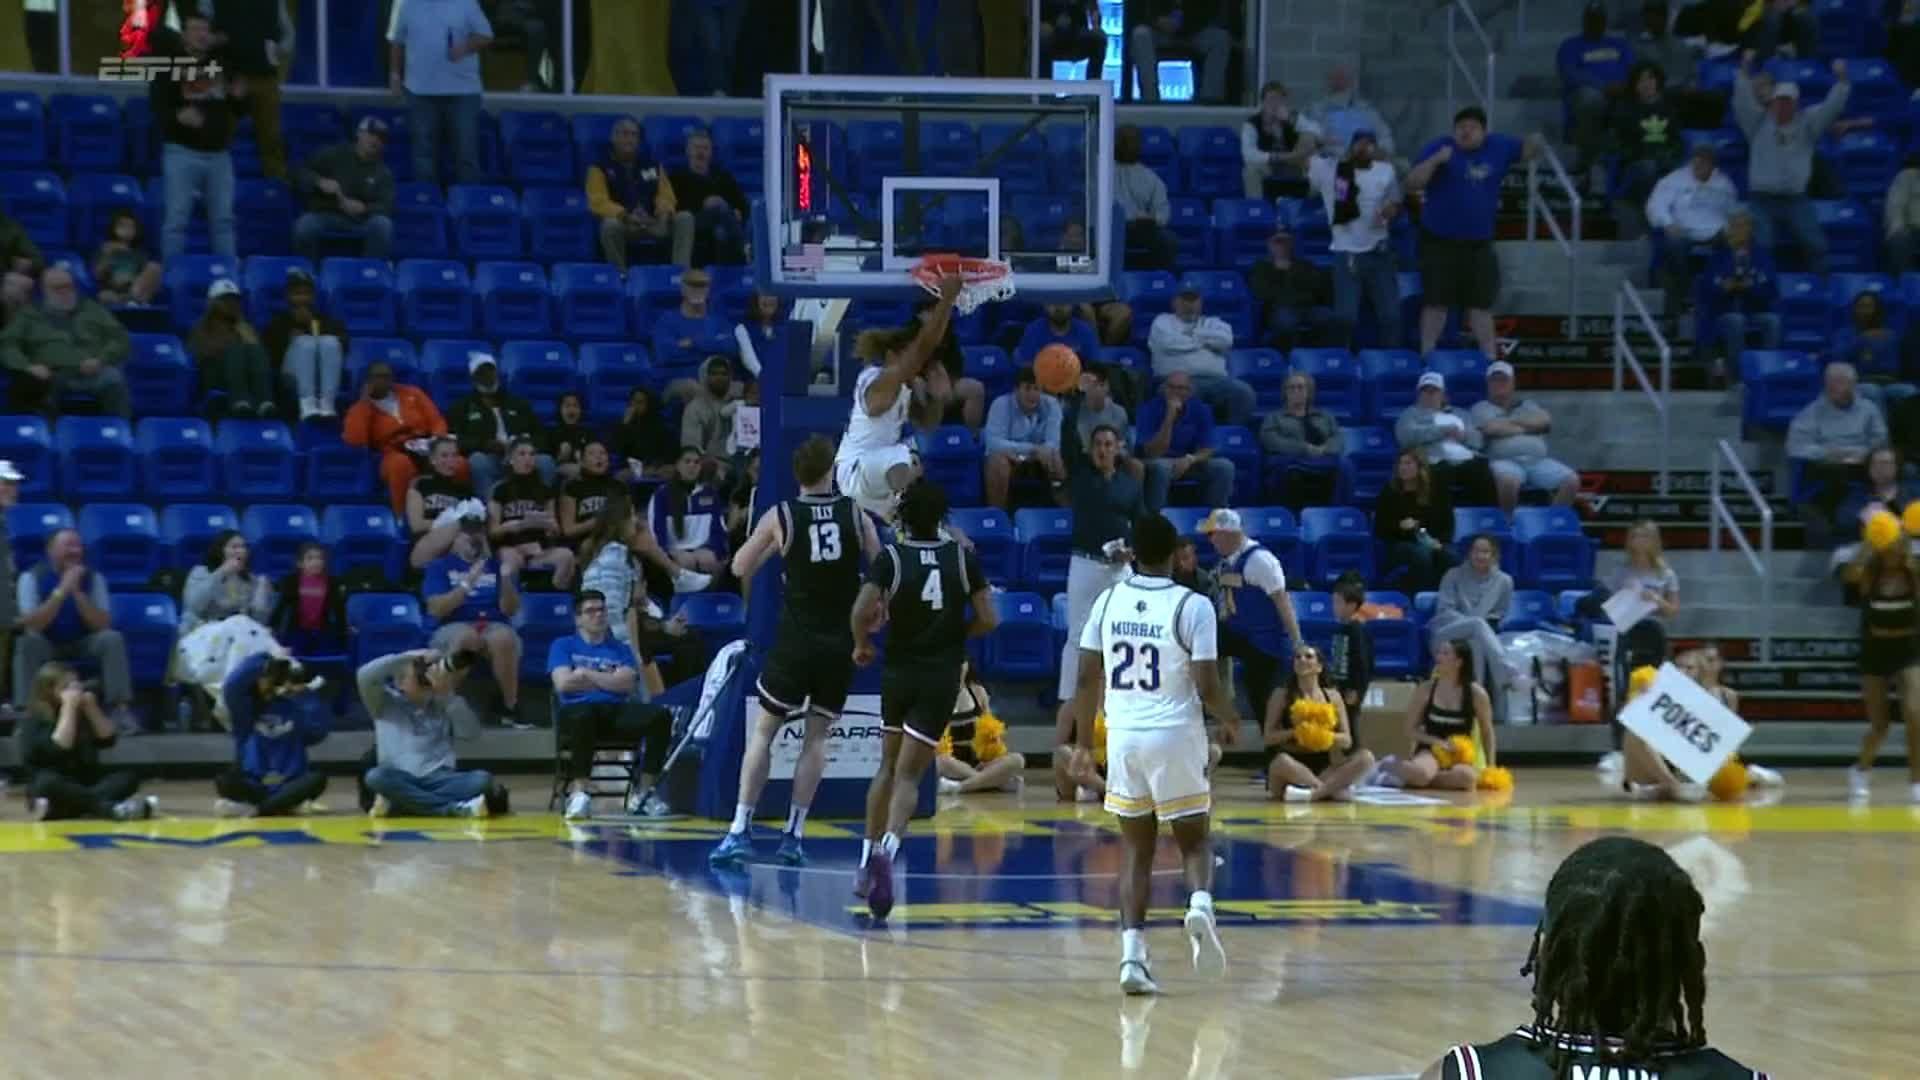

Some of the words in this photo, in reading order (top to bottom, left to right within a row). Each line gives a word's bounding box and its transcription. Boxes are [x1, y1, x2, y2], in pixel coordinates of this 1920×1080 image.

[809, 522, 841, 561] 13
[921, 568, 943, 610] 4
[1111, 621, 1164, 639] MURRAY
[1111, 641, 1160, 691] 23
[1650, 692, 1721, 753] POKES
